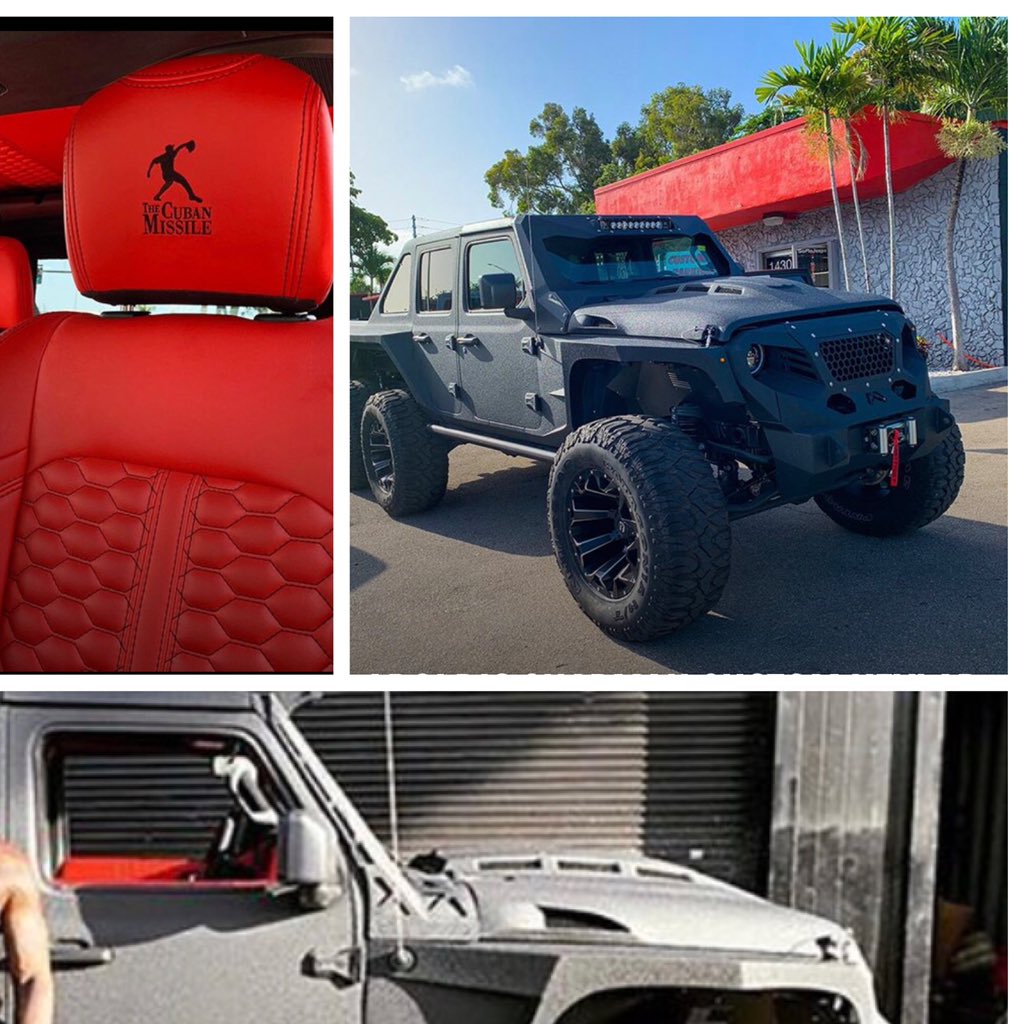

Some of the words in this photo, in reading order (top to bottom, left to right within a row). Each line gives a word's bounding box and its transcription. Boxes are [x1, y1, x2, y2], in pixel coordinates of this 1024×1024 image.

[142, 202, 160, 214] THE
[162, 202, 212, 219] CUBAN
[143, 214, 212, 235] MISSILE
[769, 258, 792, 270] 1430
